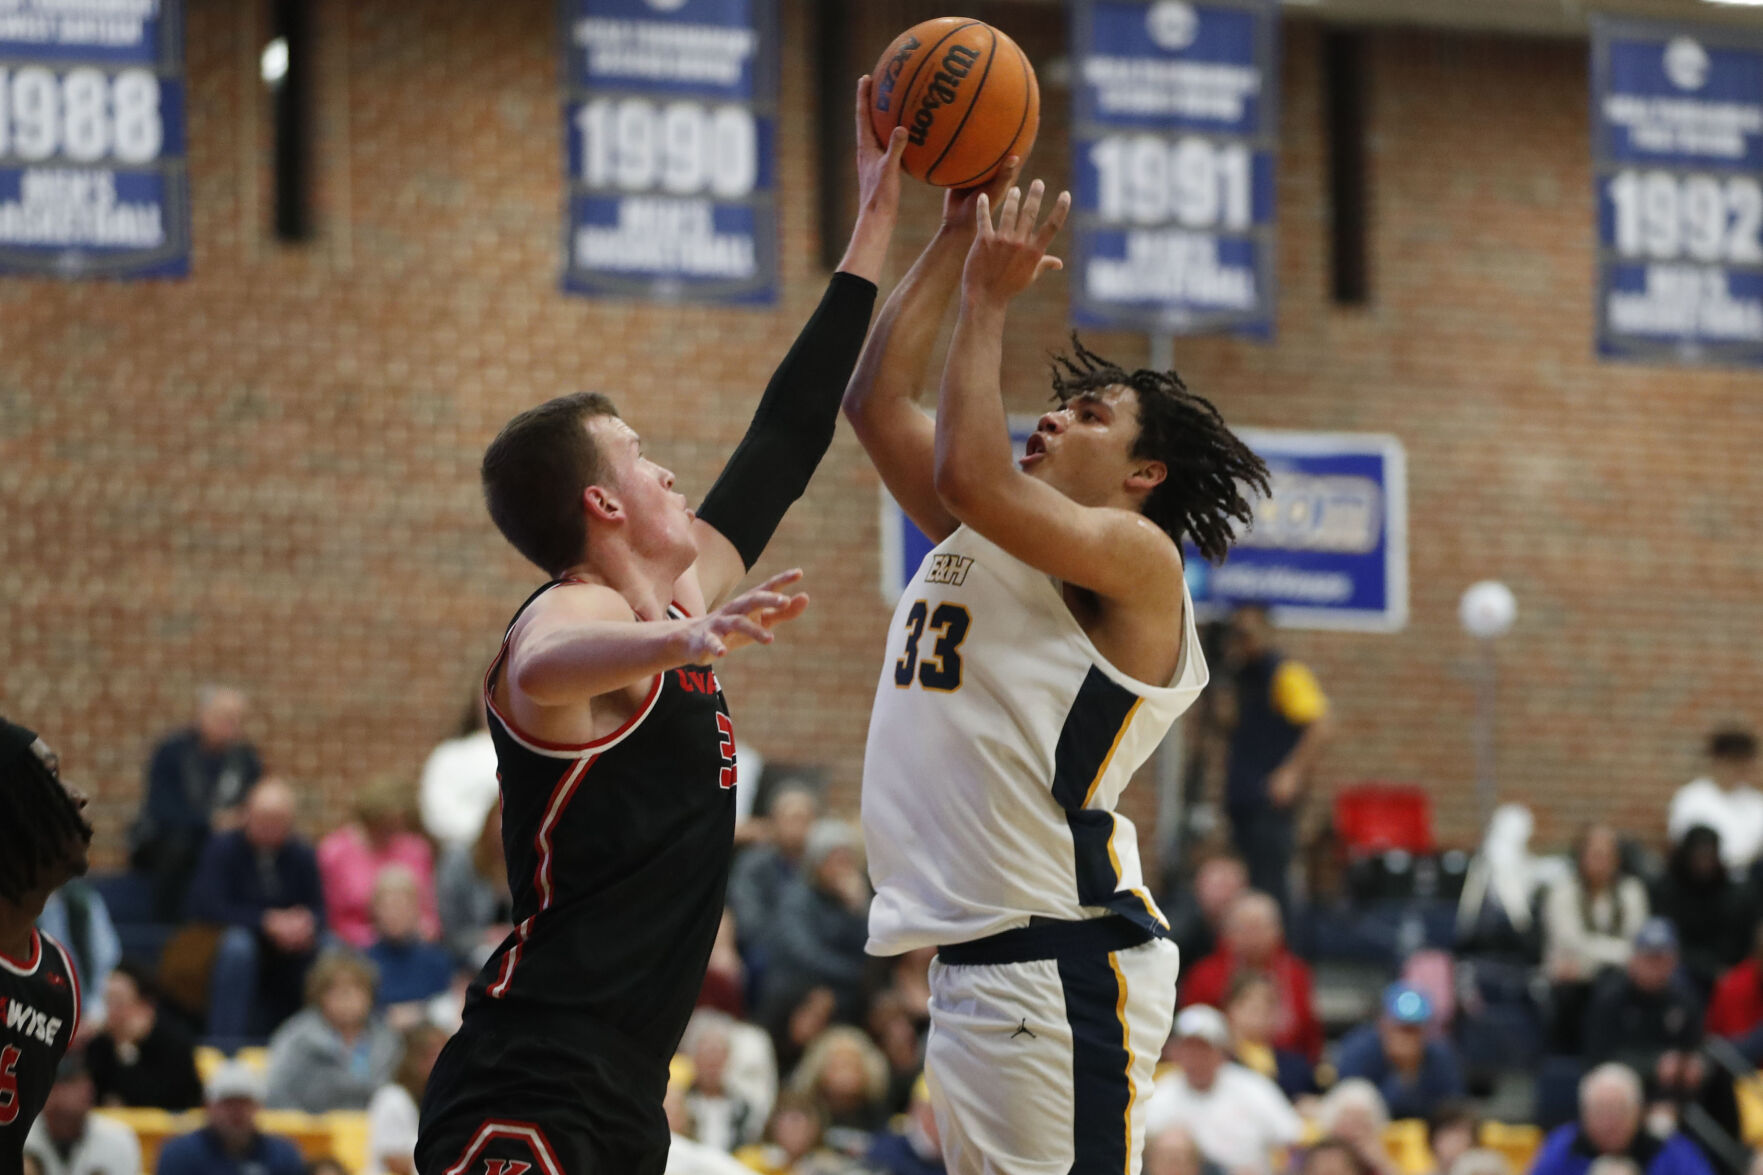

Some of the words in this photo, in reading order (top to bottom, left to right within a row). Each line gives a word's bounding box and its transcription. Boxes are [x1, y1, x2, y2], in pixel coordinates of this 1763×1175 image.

[908, 45, 980, 147] Wilson
[576, 99, 757, 200] 1990
[1091, 134, 1250, 232] 1991
[1610, 170, 1763, 266] 1992
[924, 553, 975, 587] E&H
[894, 599, 973, 693] 33
